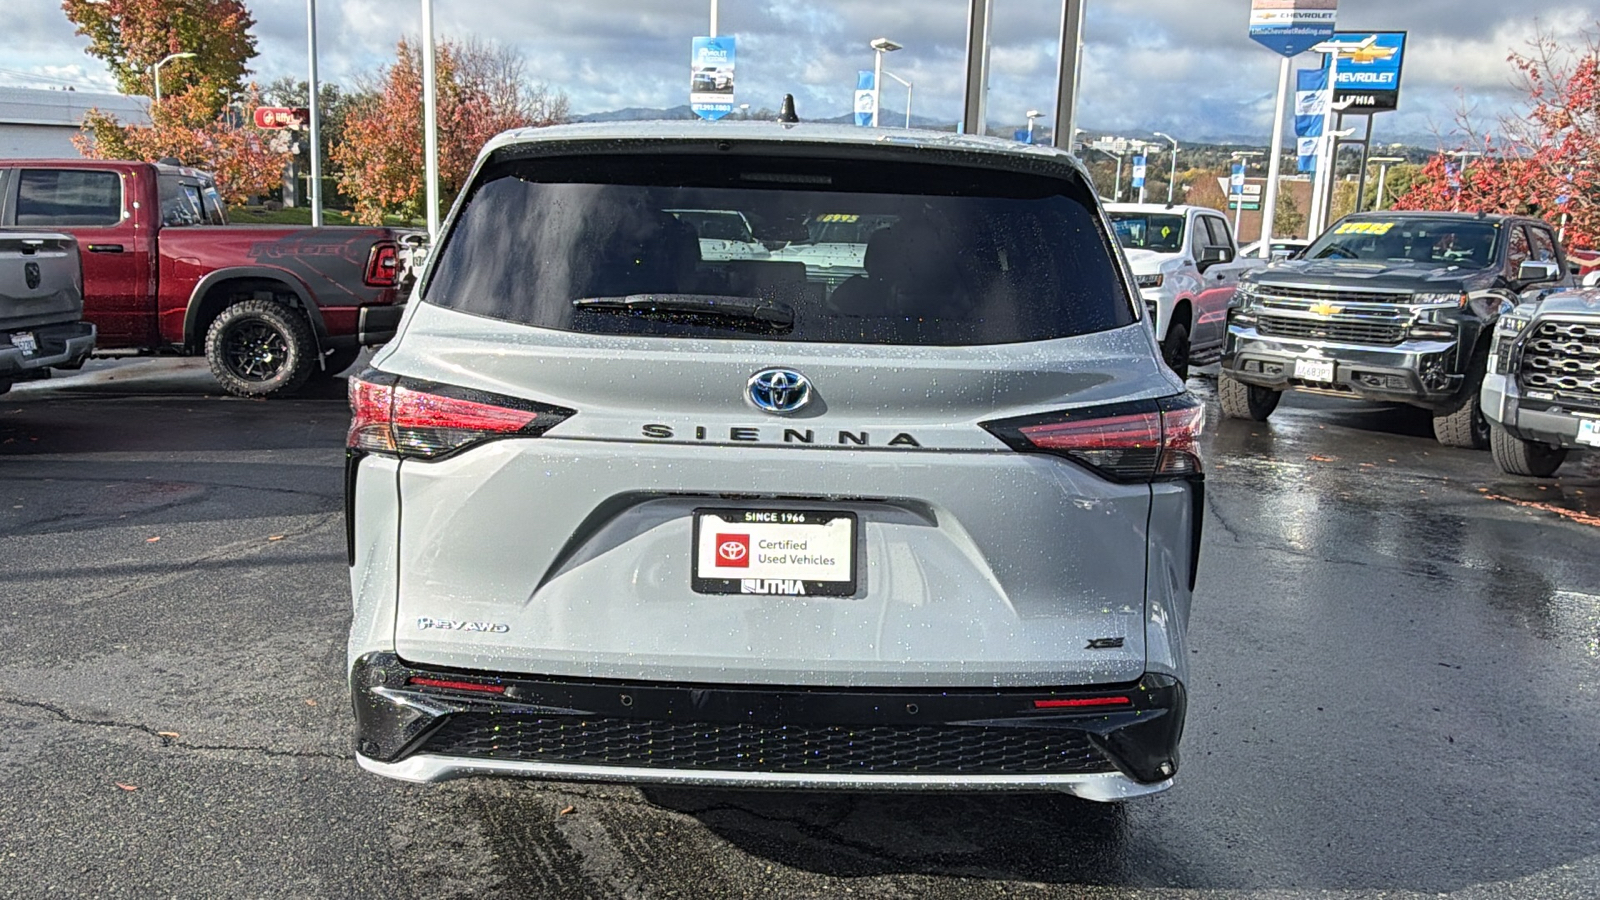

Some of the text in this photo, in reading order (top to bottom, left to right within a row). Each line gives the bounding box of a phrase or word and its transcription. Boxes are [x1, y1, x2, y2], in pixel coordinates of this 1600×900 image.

[1334, 72, 1395, 82] HEVROLET
[642, 424, 920, 447] SIENNA
[745, 512, 805, 523] SINCE 1966
[758, 539, 807, 551] Certified
[758, 554, 835, 566] Used Vehicles
[755, 579, 805, 595] LITHIA
